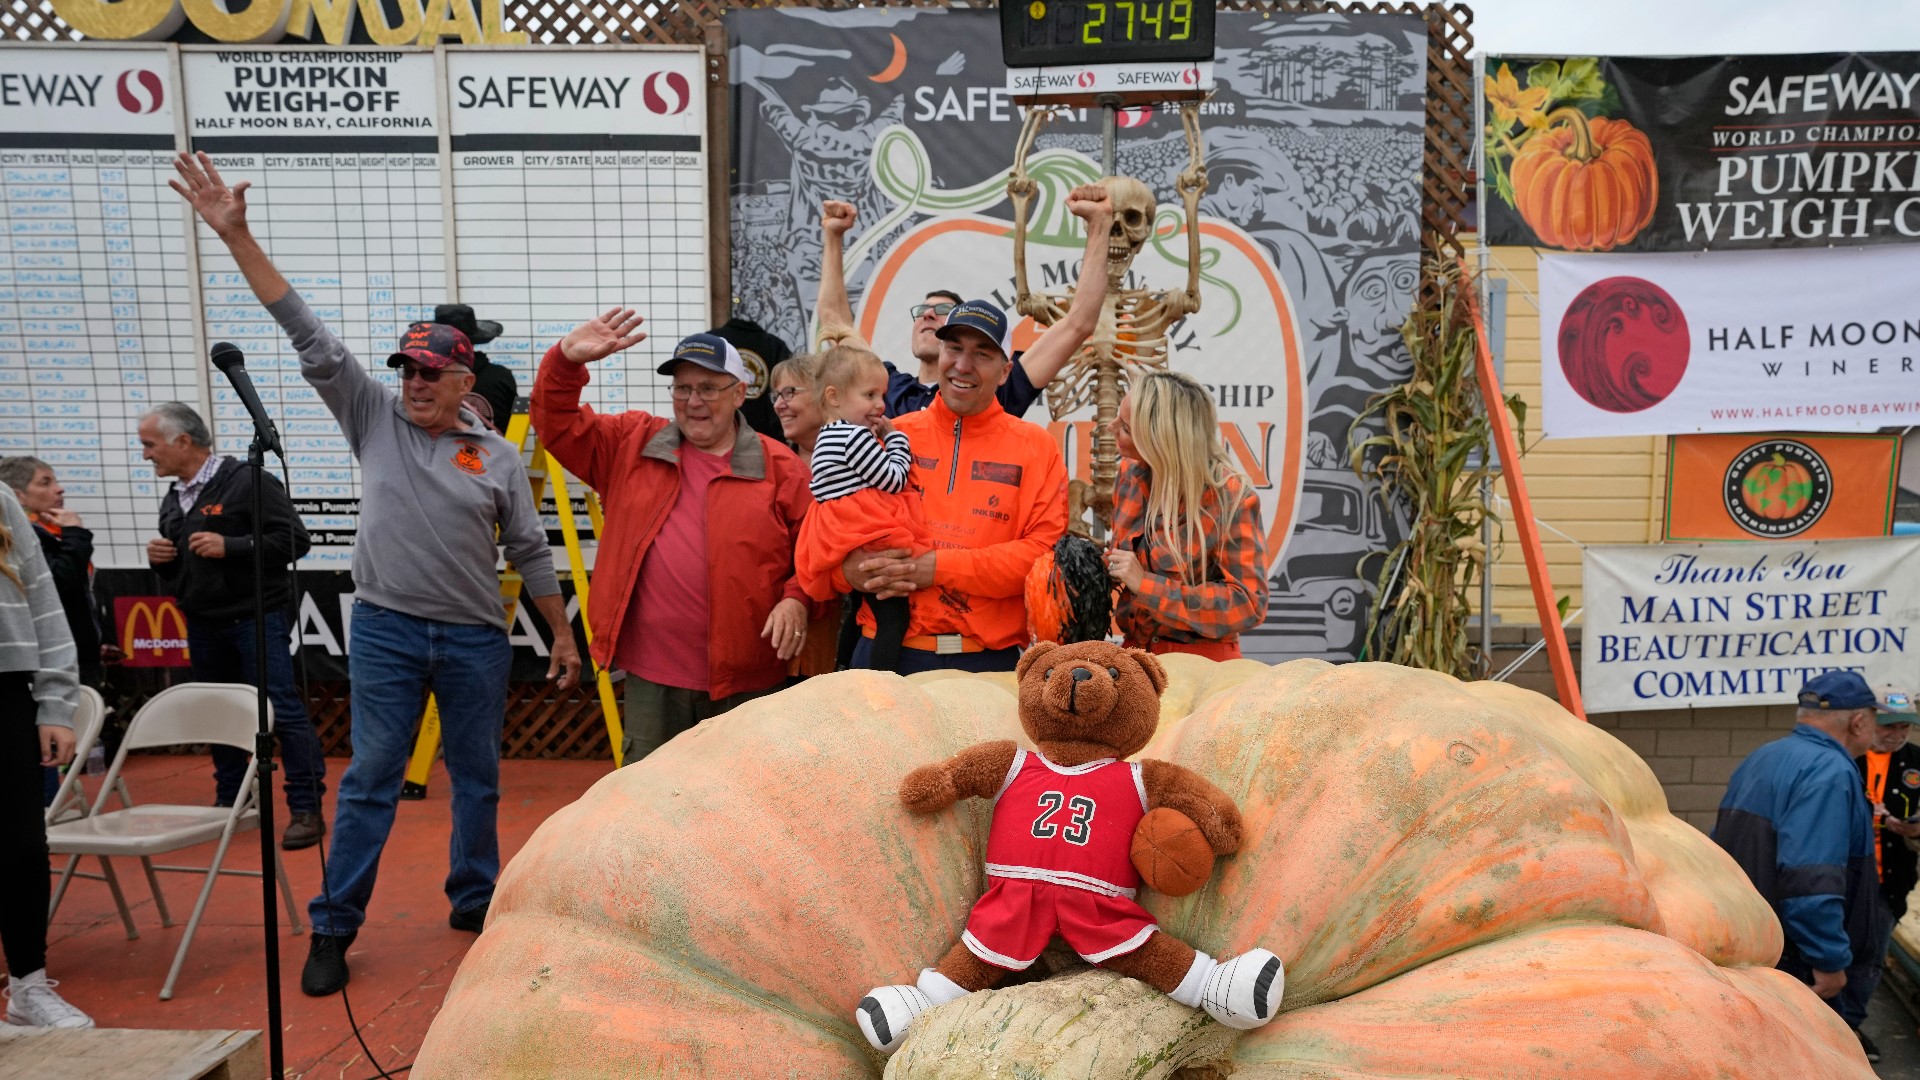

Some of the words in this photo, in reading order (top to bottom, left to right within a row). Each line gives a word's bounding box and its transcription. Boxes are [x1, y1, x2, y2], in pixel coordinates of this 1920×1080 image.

[1083, 0, 1191, 43] 2749
[217, 52, 273, 63] WORLD
[279, 52, 402, 63] CHAMPIONSHIP
[234, 66, 387, 88] PUMPKIN
[1014, 75, 1075, 88] SAFEWAY
[1118, 71, 1181, 85] SAFEWAY
[0, 74, 103, 107] EWAY
[225, 91, 400, 112] WEIGH-OFF
[458, 75, 631, 108] SAFEWAY
[1724, 71, 1920, 116] SAFEWAY
[1162, 102, 1235, 115] PRENTS
[195, 118, 235, 128] HALF
[240, 117, 287, 128] MOON
[294, 117, 331, 129] BAY,
[336, 117, 433, 128] CALIFORNIA
[1713, 129, 1796, 146] WORLD
[1806, 125, 1920, 142] CHAMPIO
[212, 157, 255, 167] ROWER
[335, 158, 356, 167] PLACE
[361, 158, 385, 167] WEIGHT
[389, 158, 411, 167] HEIGHT
[463, 156, 514, 166] GROWER
[595, 156, 616, 166] PLACE
[621, 156, 645, 166] WEIGHT
[649, 156, 671, 166] HEIGHT
[1714, 151, 1920, 196] PUMPKI
[1675, 197, 1920, 242] WEIGH-O
[537, 323, 574, 334] WINNE
[1709, 325, 1794, 351] HALF
[1809, 320, 1920, 347] MOON
[1762, 357, 1914, 377] WINER
[1711, 402, 1920, 419] WWW.HALFMOONBAYWI
[1731, 446, 1767, 478] GREAT
[1775, 444, 1825, 482] PUMPKIN
[1731, 498, 1821, 532] COMMONWEALTH
[1654, 553, 1773, 584] Thank
[1782, 550, 1853, 583] You
[1620, 596, 1732, 624] MAIN
[1746, 590, 1888, 621] STREET
[134, 638, 188, 649] McDona
[1597, 627, 1908, 663] BEAUTIFICATION
[1633, 666, 1865, 698] COMMITT
[1031, 790, 1097, 847] 23
